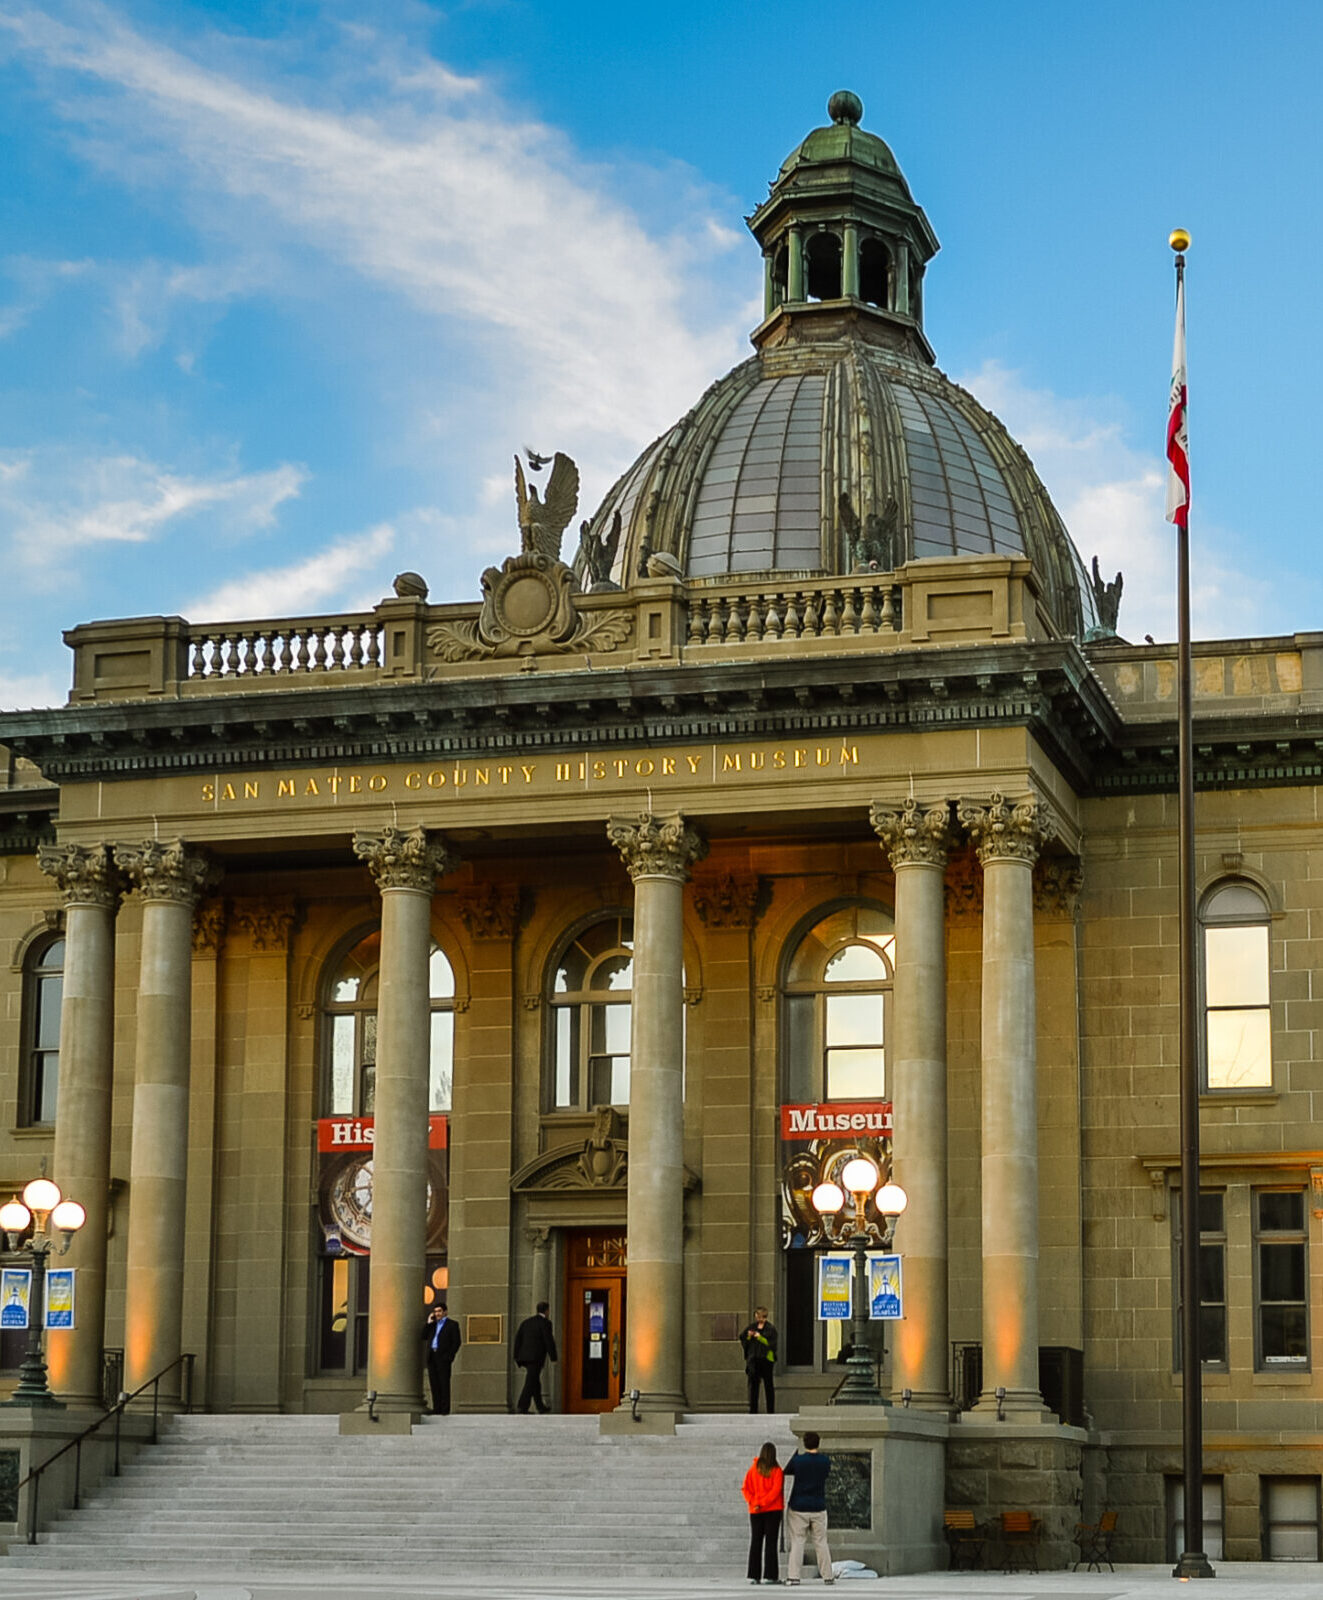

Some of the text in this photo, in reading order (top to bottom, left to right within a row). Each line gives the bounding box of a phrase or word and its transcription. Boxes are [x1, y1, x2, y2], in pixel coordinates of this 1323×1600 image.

[202, 746, 860, 801] SAN MATEO COUNTY HISTORY MUSEUM
